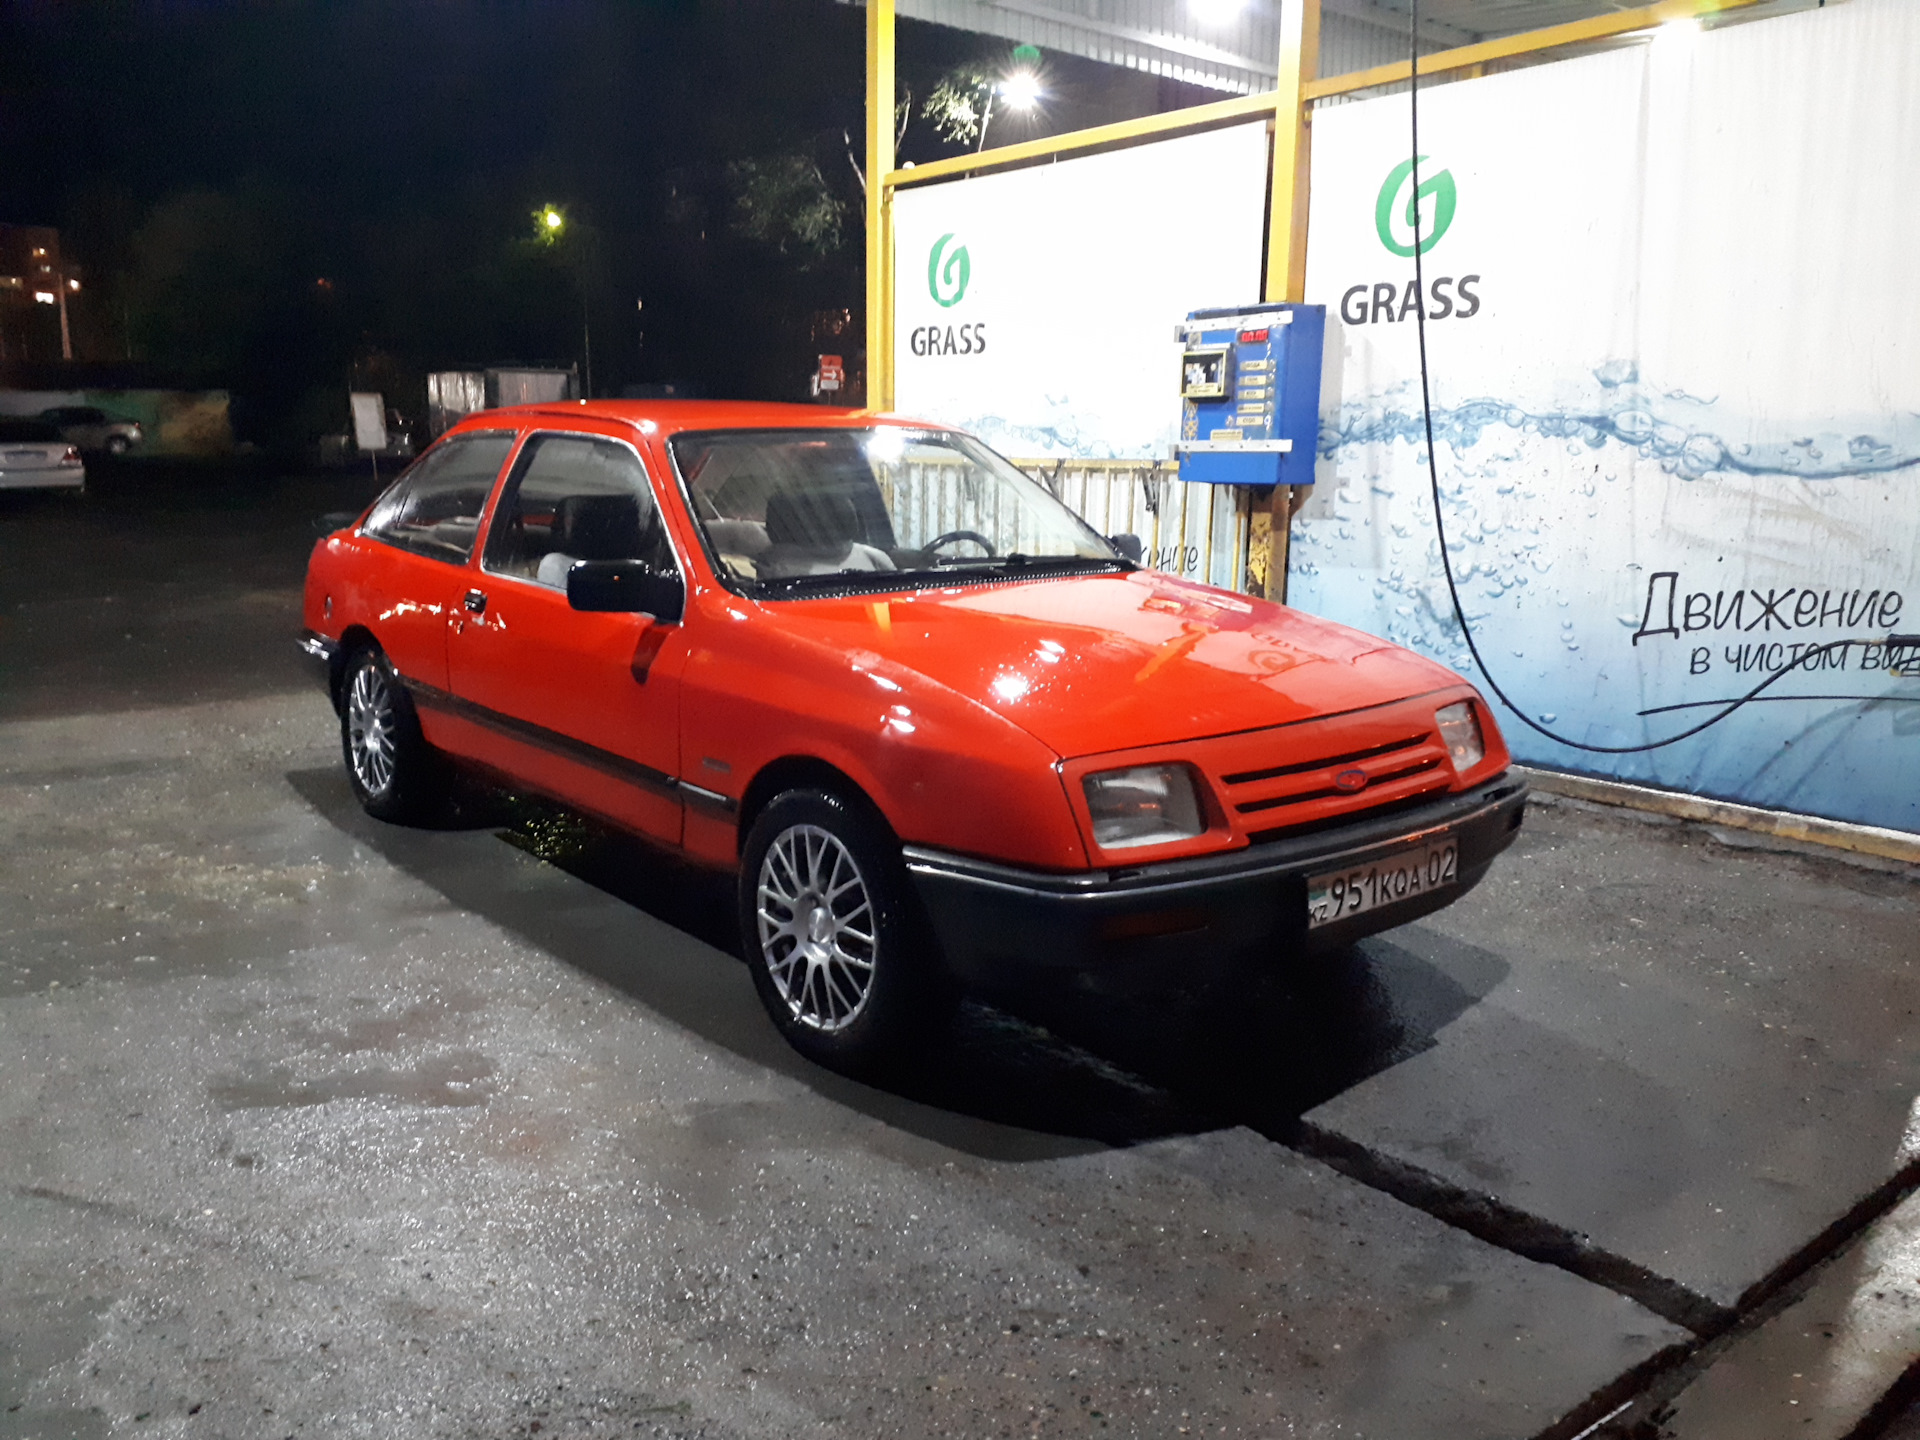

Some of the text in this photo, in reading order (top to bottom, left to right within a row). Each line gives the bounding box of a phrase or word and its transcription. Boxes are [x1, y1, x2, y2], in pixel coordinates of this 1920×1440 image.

[1340, 274, 1481, 326] GRASS
[910, 322, 986, 357] GRASS
[1141, 545, 1199, 573] ение
[1632, 571, 1903, 647] Движение
[1724, 642, 1850, 673] чистом
